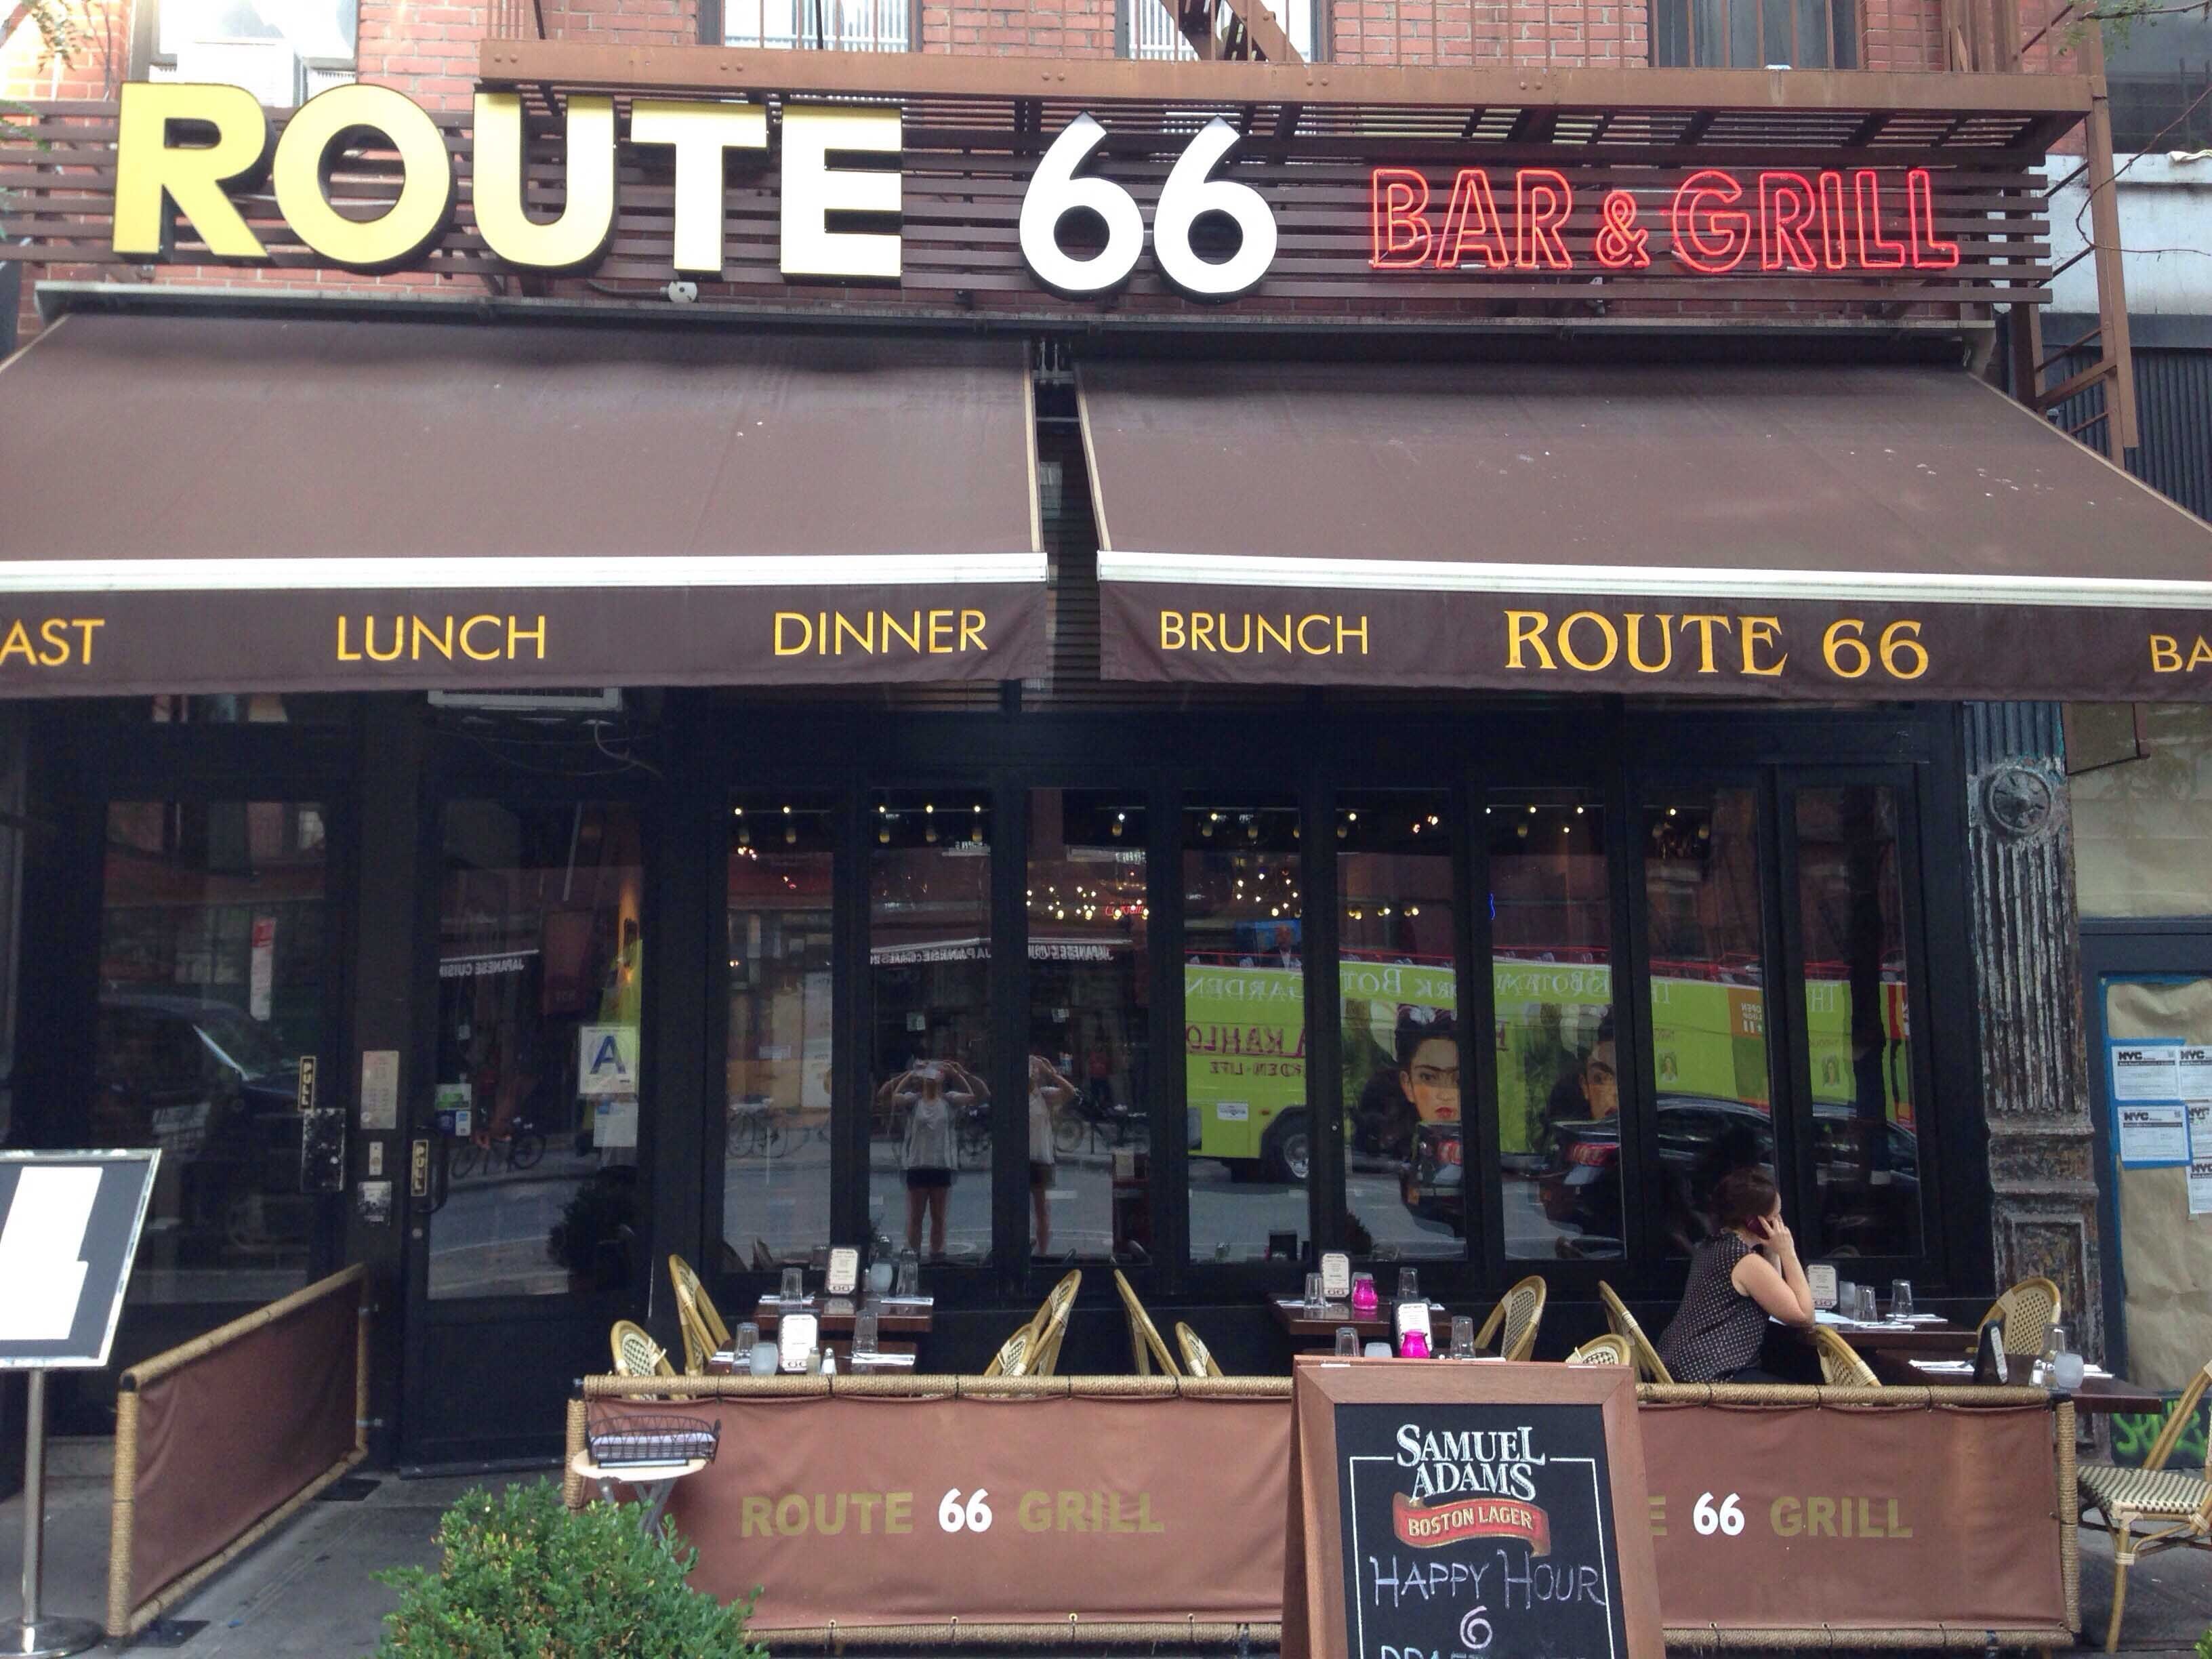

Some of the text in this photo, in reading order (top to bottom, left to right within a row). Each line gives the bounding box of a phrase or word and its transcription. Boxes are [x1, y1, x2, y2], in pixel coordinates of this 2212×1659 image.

[112, 81, 1278, 293] ROUTE 66
[1369, 168, 1961, 274] BAR & GRILL
[0, 609, 989, 667] AST LUNCH DINNER
[1160, 610, 1368, 655] BRUNCH
[1503, 610, 1788, 676] ROUTE
[1822, 618, 1929, 680] 66
[589, 1034, 626, 1075] A
[1396, 1423, 1546, 1468] SAMUEL
[1409, 1462, 1538, 1503] ADAMS
[741, 1488, 1165, 1538] ROUTE 66 GRILL
[1408, 1506, 1534, 1537] BOSTON LAGER
[1692, 1491, 1746, 1536] 66
[1769, 1496, 1914, 1538] GRILL
[1369, 1549, 1607, 1610] HAPPY HOUR
